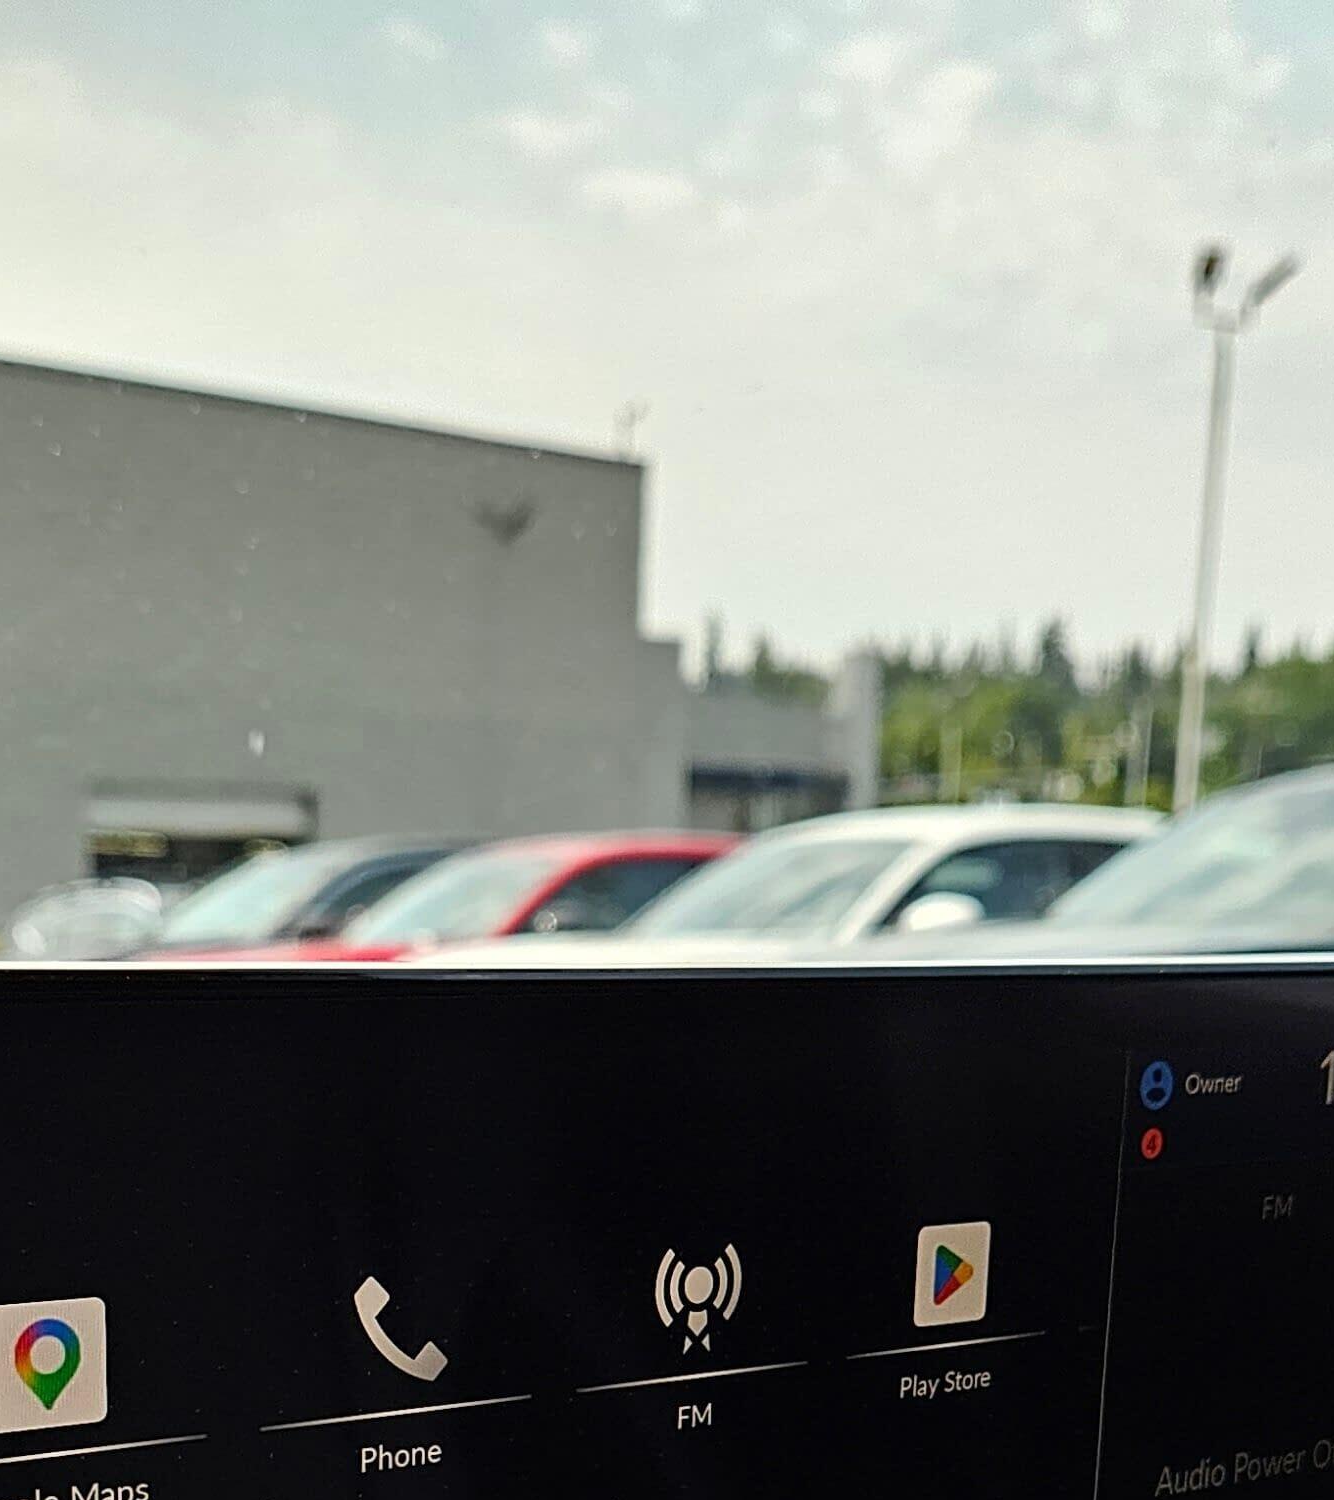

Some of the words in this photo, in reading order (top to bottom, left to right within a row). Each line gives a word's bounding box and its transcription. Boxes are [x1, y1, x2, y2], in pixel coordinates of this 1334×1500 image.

[1185, 1073, 1242, 1095] Owner
[1261, 1194, 1294, 1220] FM
[899, 1374, 940, 1400] Play
[944, 1370, 991, 1393] Store
[677, 1402, 712, 1430] FM
[361, 1443, 443, 1474] Phone
[1154, 1464, 1226, 1498] Audio
[1234, 1452, 1303, 1483] Power
